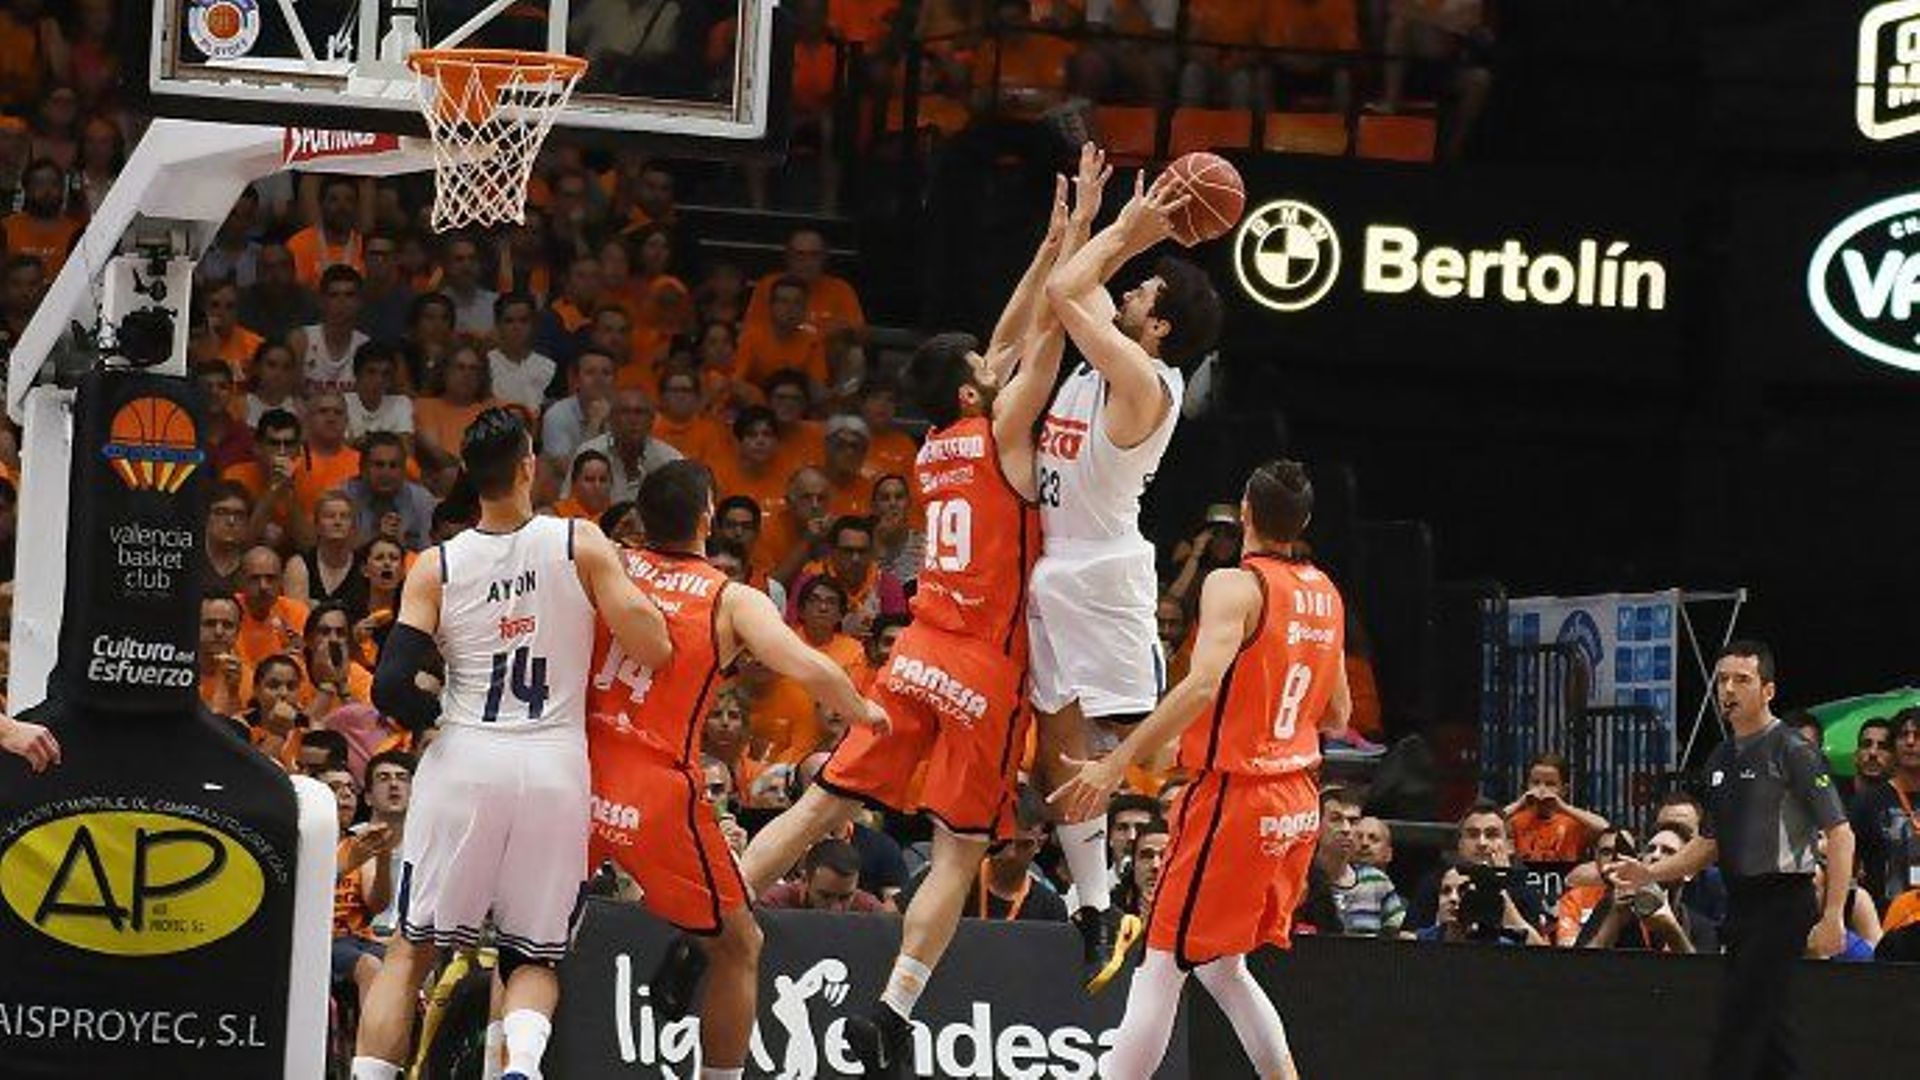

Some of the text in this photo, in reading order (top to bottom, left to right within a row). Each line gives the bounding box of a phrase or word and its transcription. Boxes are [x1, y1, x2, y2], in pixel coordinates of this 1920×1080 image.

[1362, 224, 1667, 310] Bertolín
[110, 524, 192, 548] valencia
[118, 544, 182, 569] basket
[925, 498, 972, 572] 19
[125, 568, 171, 588] club
[487, 571, 536, 602] AYON
[93, 634, 175, 661] Cultura
[88, 657, 193, 687] Esfuerzo
[482, 646, 549, 722] 14
[890, 654, 988, 719] PAMESA
[1274, 663, 1312, 740] 8
[34, 824, 228, 934] AP
